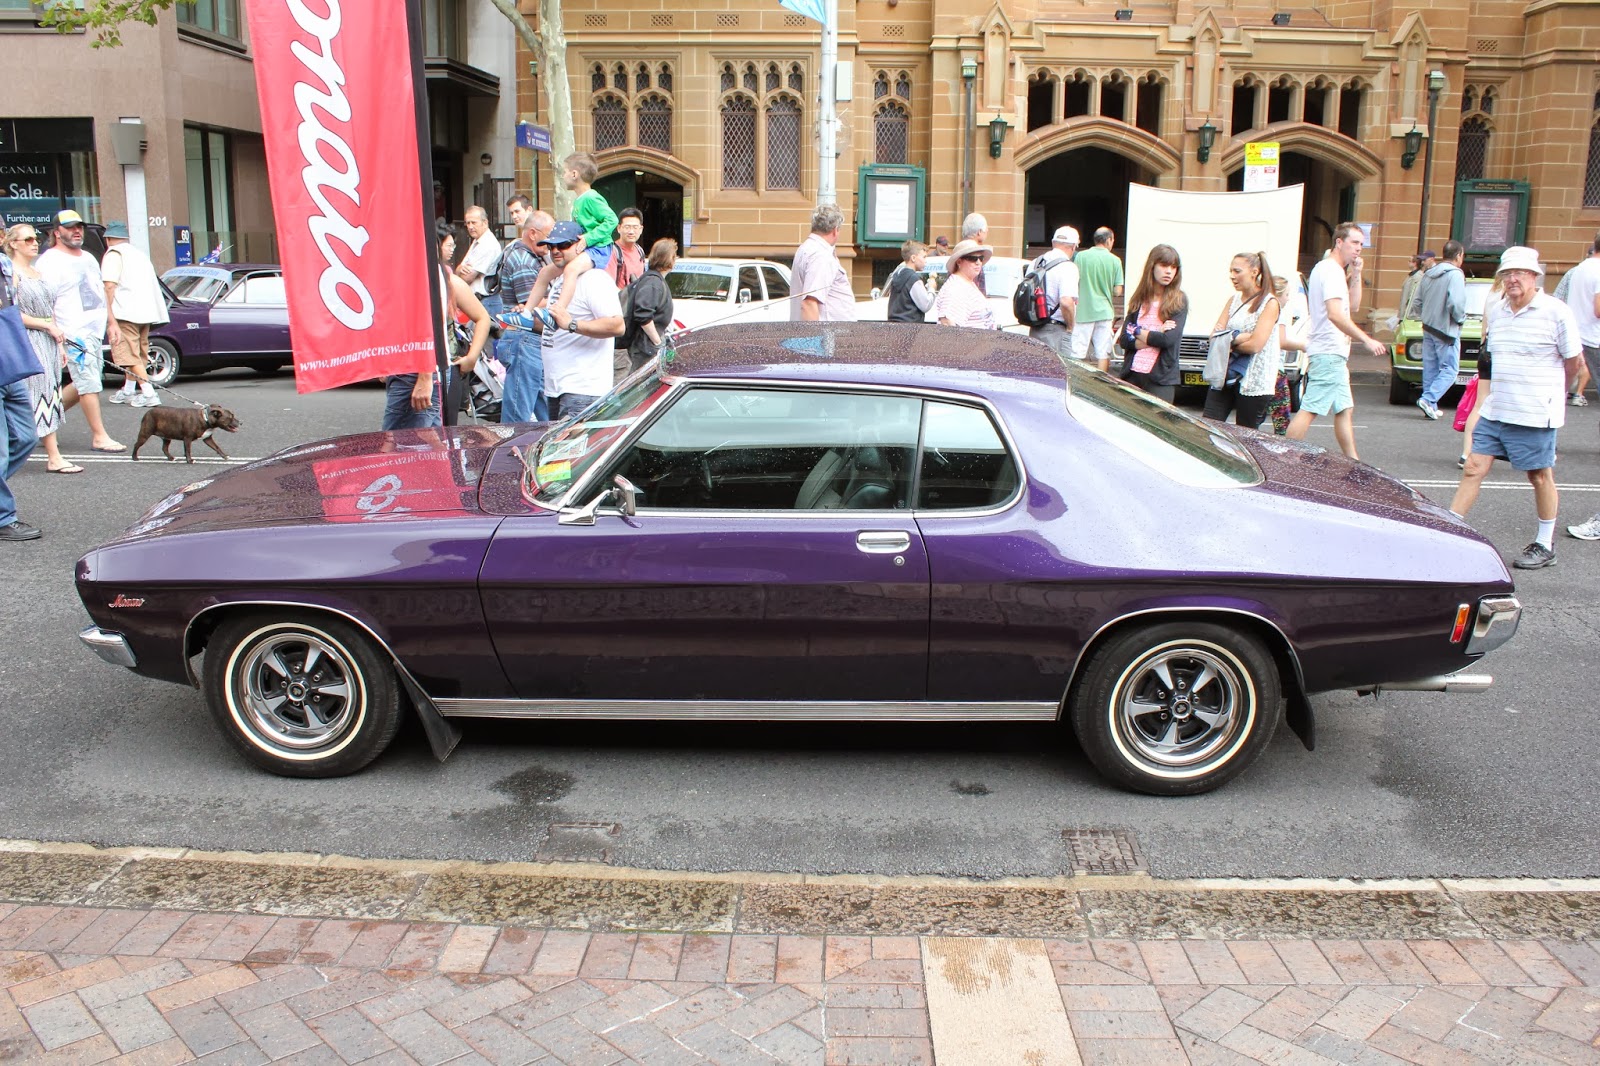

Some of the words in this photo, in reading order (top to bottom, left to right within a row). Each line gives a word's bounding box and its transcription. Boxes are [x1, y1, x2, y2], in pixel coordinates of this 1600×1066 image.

[9, 183, 43, 200] Sale
[6, 214, 36, 223] Further
[36, 214, 51, 222] and
[149, 216, 167, 227] 201
